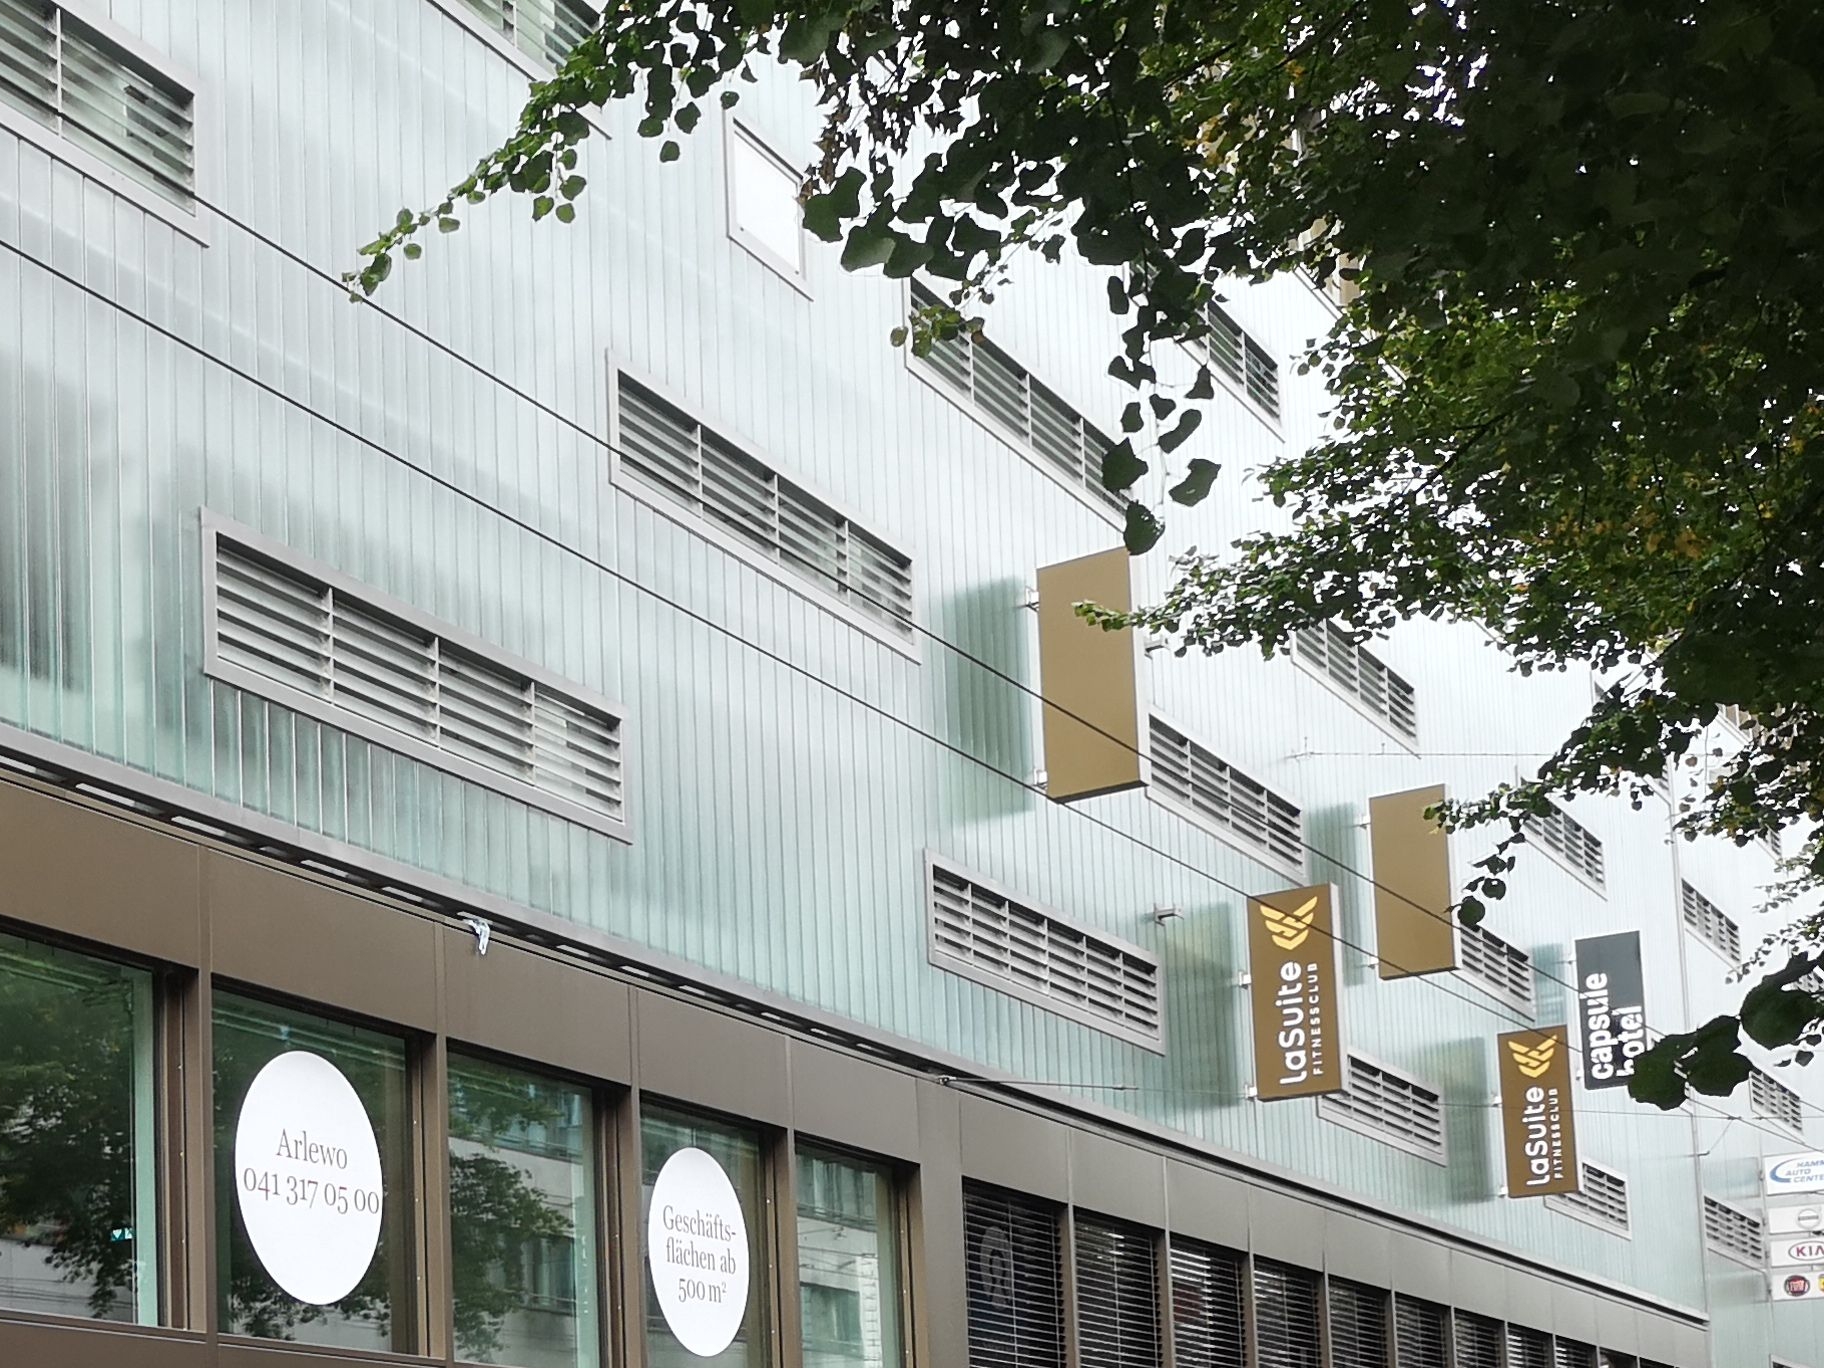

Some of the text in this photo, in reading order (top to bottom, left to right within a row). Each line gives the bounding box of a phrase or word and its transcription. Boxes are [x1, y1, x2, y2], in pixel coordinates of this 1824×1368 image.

[1580, 973, 1619, 1080] capsule
[276, 1128, 348, 1169] Arlewo
[243, 1167, 379, 1215] 041 317 05 00
[1785, 1168, 1812, 1176] AUTO
[663, 1204, 736, 1242] Geschäfts-
[666, 1236, 736, 1275] flächen ab
[678, 1278, 705, 1303] 500
